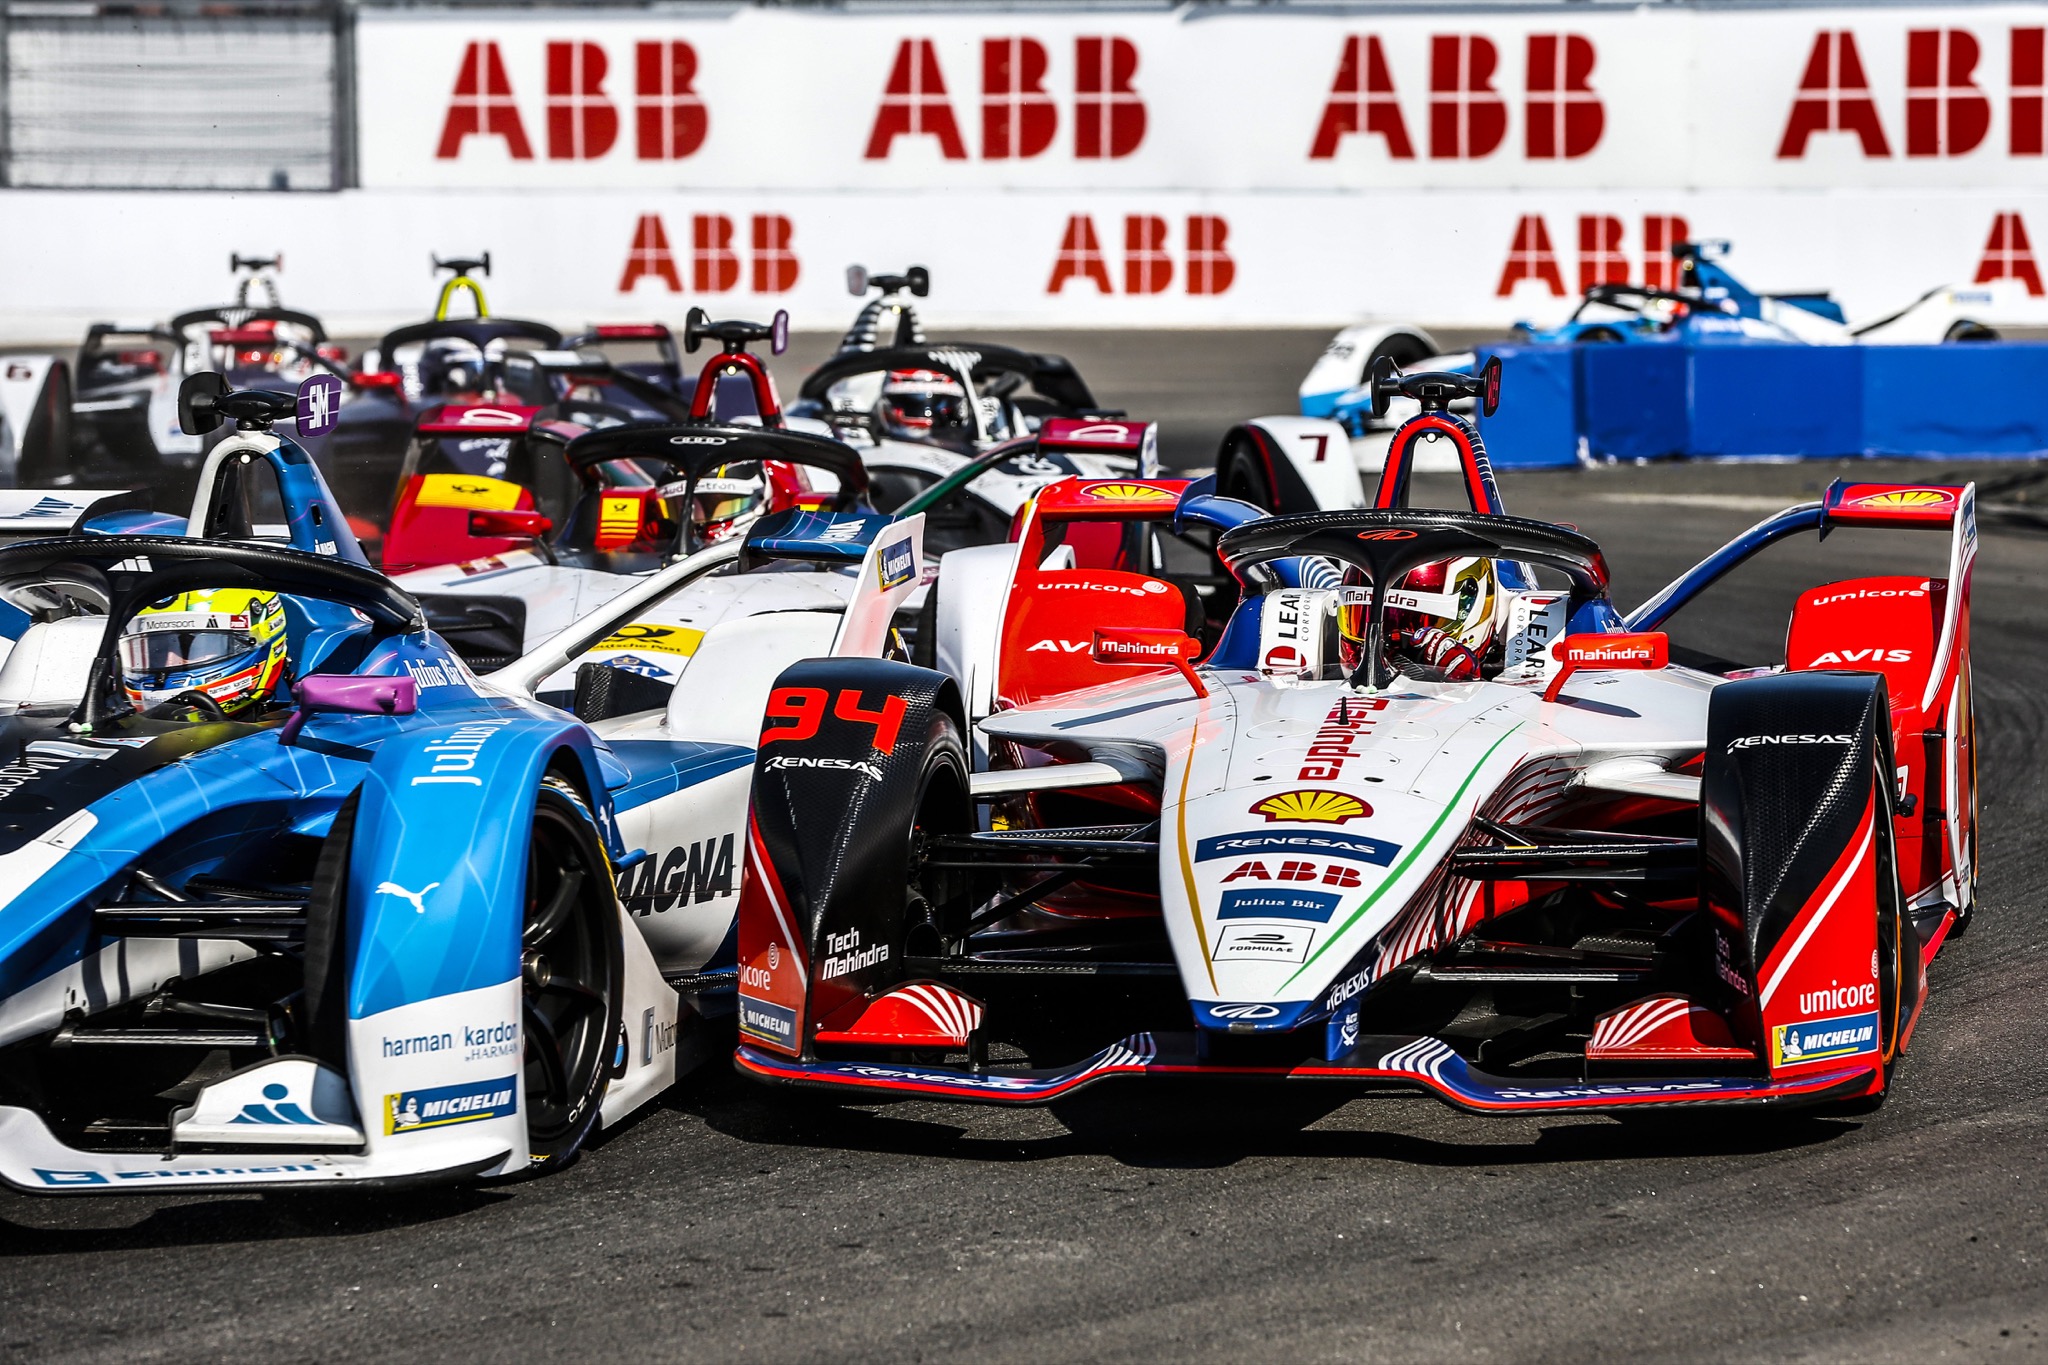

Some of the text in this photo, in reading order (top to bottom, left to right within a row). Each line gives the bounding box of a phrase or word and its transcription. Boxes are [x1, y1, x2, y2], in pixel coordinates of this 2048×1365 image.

[435, 40, 709, 160] ABB
[863, 36, 1148, 160] ABB
[1308, 33, 1606, 159] ABB
[618, 213, 800, 294] ABB
[1046, 213, 1236, 295] ABB
[1300, 435, 1329, 463] 7
[663, 485, 684, 495] Aud
[1038, 582, 1146, 597] umicore
[1346, 591, 1417, 608] Mahdra
[1813, 588, 1925, 606] umicore
[147, 619, 195, 630] Motorsport
[1278, 594, 1302, 639] LEAR
[1101, 640, 1179, 655] Mahindra
[1525, 609, 1549, 669] LEAR
[1568, 648, 1650, 661] Mahindra
[1808, 648, 1913, 667] AVIS
[760, 687, 908, 757] 94
[1297, 697, 1390, 780] Mahindra
[1727, 733, 1853, 755] RENESAS
[410, 726, 501, 787] Julius
[765, 755, 884, 782] RENESAS
[1216, 837, 1376, 855] RENESAS
[1219, 861, 1362, 888] ABB
[1234, 898, 1325, 910] Julius Bär
[827, 927, 859, 955] Tech
[822, 943, 889, 981] Mahindra
[1327, 966, 1371, 1011] RENESAS
[1800, 979, 1875, 1015] umicore
[747, 1010, 791, 1036] MICHELIN
[383, 1032, 452, 1058] harman
[1803, 1025, 1874, 1050] MICHELIN
[837, 1065, 1034, 1090] RENESAS
[421, 1089, 512, 1118] MICHELIN
